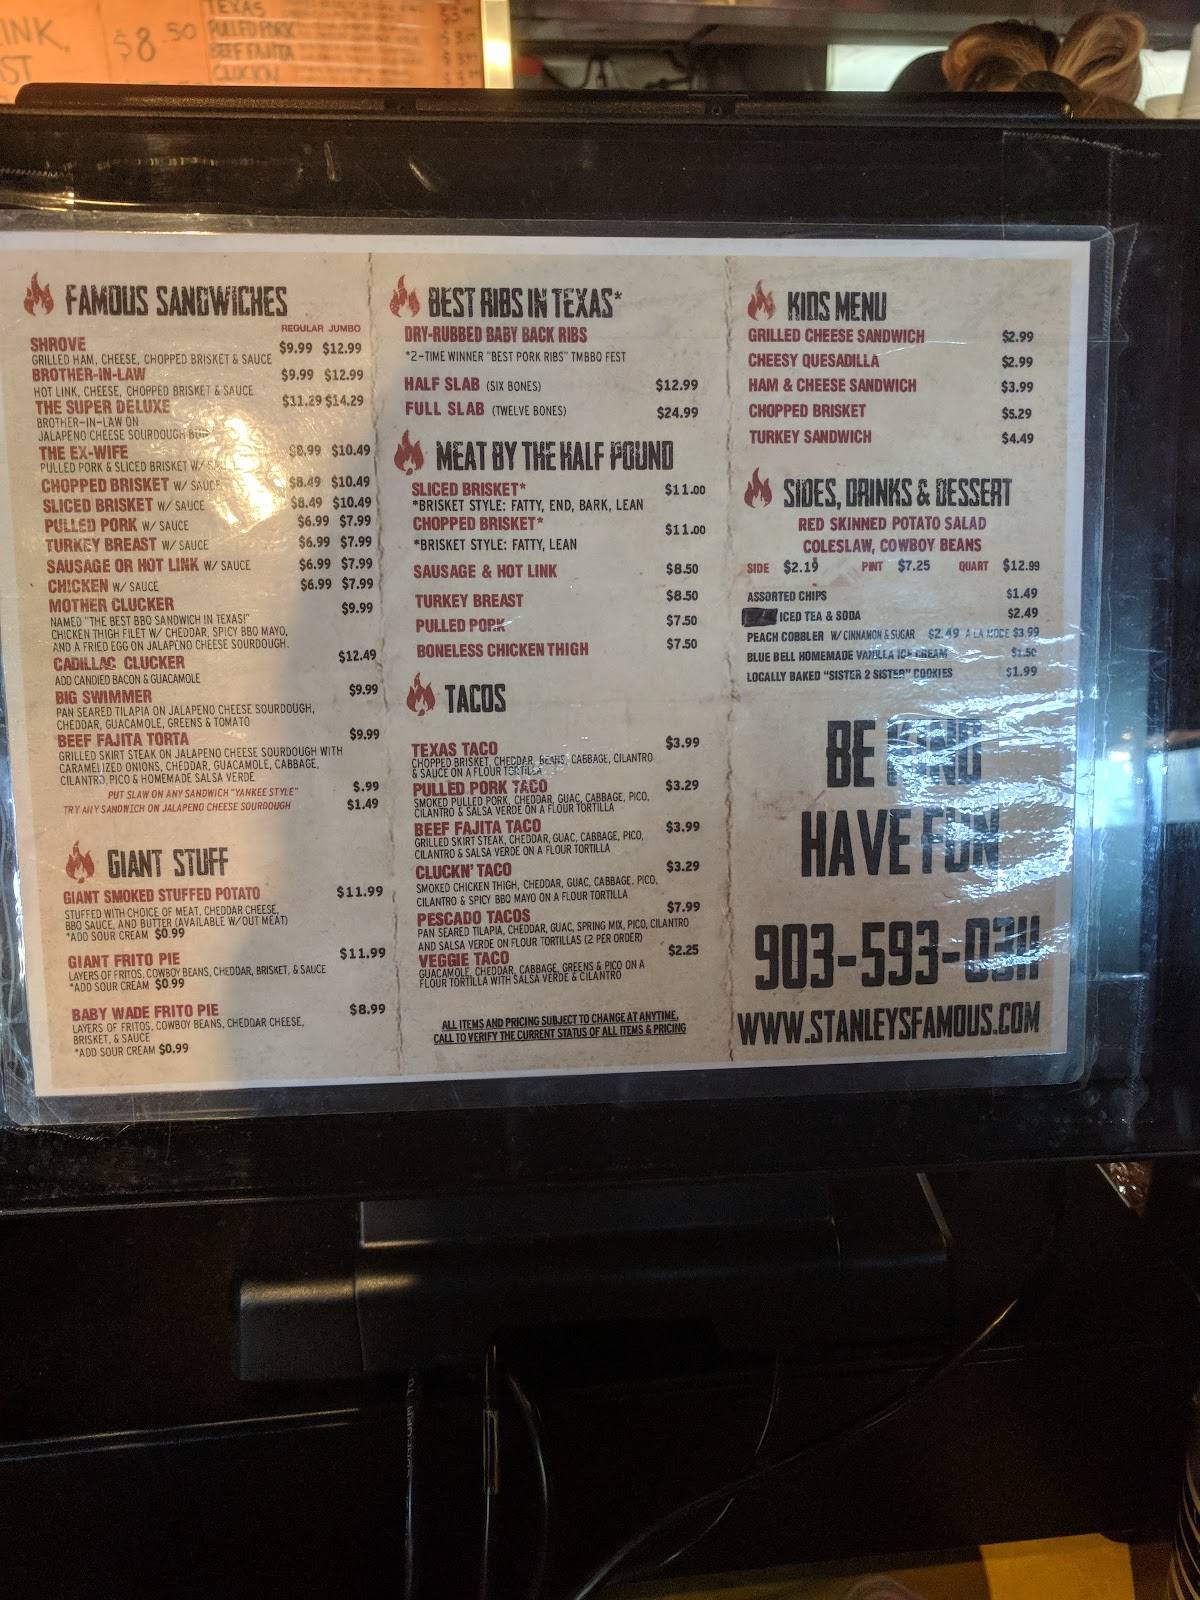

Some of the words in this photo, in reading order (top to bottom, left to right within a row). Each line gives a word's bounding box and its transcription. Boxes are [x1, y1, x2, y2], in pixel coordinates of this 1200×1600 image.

[66, 284, 148, 316] FAMOUS
[156, 285, 287, 316] SANDWICHES
[429, 287, 475, 317] BEST
[480, 288, 523, 318] RIBS
[528, 288, 547, 318] IN
[788, 292, 830, 321] KIDS
[835, 292, 887, 321] MENU
[405, 326, 482, 343] DRY-RUBBED
[486, 327, 517, 343] BABY
[522, 327, 554, 343] BACK
[558, 327, 587, 343] RIBS
[749, 328, 800, 342] GRILLED
[805, 329, 853, 343] CHEESE
[857, 329, 925, 343] SANDWICH
[1002, 330, 1034, 343] $2.99
[30, 337, 86, 351] SHROVE
[280, 341, 312, 355] $9.99
[322, 342, 362, 355] $12.99
[32, 354, 69, 365] GRILLED
[73, 355, 97, 365] HAM,
[101, 354, 139, 365] CHEESE,
[144, 354, 187, 364] CHOPPED
[191, 354, 229, 365] BRISKET
[232, 353, 238, 364] &
[242, 353, 272, 364] SAUCE
[748, 353, 798, 367] CHEESY
[802, 353, 879, 368] QUESADILLA
[1002, 355, 1033, 368] $2.99
[32, 368, 145, 382] BROTHER-IN-LAW
[281, 368, 313, 381] $9.99
[324, 369, 363, 382] $12.99
[405, 377, 440, 391] HALF
[444, 377, 480, 391] SLAB
[487, 381, 503, 392] (SIX
[508, 381, 541, 392] BONES)
[656, 379, 698, 392] $12.99
[35, 400, 62, 415] THE
[66, 400, 112, 414] SUPER
[117, 400, 170, 414] DELUXE
[282, 395, 322, 408] $11.29
[325, 395, 363, 407] $14.29
[750, 430, 800, 444] TURKEY
[804, 429, 872, 444] SANDWICH
[1002, 432, 1034, 445] $4.49
[436, 441, 487, 470] MEAT
[492, 441, 517, 471] BY
[522, 441, 556, 471] THE
[560, 441, 604, 470] HALF
[610, 441, 673, 470] POUND
[412, 482, 458, 496] SLICED
[665, 483, 705, 496] $11.00
[784, 478, 841, 510] SIDES,
[846, 478, 912, 508] DRINKS
[917, 479, 930, 507] &
[936, 478, 1012, 507] DESSERT
[470, 500, 506, 511] STYLE:
[512, 500, 544, 512] FATTY,
[550, 500, 574, 512] END,
[579, 499, 611, 512] BARK,
[616, 499, 643, 510] LEAN
[45, 519, 96, 533] PULLED
[101, 518, 137, 532] PORK
[142, 522, 157, 531] W/
[160, 521, 189, 531] SAUCE
[298, 515, 329, 528] $6.99
[340, 515, 371, 528] $7.99
[799, 518, 824, 532] RED
[830, 517, 886, 531] SKINNED
[892, 516, 940, 530] POTATO
[945, 516, 987, 530] SALAD
[47, 559, 110, 574] SAUSAGE
[115, 559, 133, 572] OR
[138, 559, 163, 572] HOT
[169, 558, 199, 572] LINK
[204, 560, 217, 571] W/
[221, 560, 251, 570] SAUCE
[300, 558, 330, 571] $6.99
[341, 558, 372, 571] $7.99
[414, 564, 476, 578] SAUSAGE
[482, 564, 492, 578] &
[497, 564, 523, 578] HOT
[528, 564, 557, 578] LINK
[666, 563, 698, 575] $8.50
[747, 563, 769, 574] SIDE
[784, 560, 818, 575] $2.19
[862, 561, 883, 572] PINT
[898, 559, 930, 573] $7.25
[959, 561, 988, 571] QUART
[1003, 558, 1040, 572] $12.99
[49, 598, 107, 612] MOTHER
[112, 597, 174, 611] CLUCKER
[342, 602, 373, 615] $9.99
[780, 611, 801, 622] ICED
[805, 611, 822, 621] TEA
[826, 610, 832, 620] &
[836, 610, 861, 620] SODA
[1008, 608, 1038, 620] $2.49
[417, 644, 483, 658] BONELESS
[487, 643, 544, 657] CHICKEN
[548, 642, 588, 656] THIGH
[667, 638, 697, 650] $7.50
[54, 657, 116, 671] CADILLAC
[124, 656, 185, 670] CLUCKER
[339, 649, 376, 663] $12.49
[55, 675, 72, 685] ADD
[74, 675, 110, 685] CANDIED
[113, 675, 140, 684] BACON
[144, 675, 148, 684] &
[151, 673, 200, 684] GUACAMOLE
[445, 684, 506, 713] TACOS
[411, 744, 456, 757] TEXAS
[462, 742, 498, 756] TACO
[666, 736, 699, 750] $3.99
[826, 720, 876, 788] BE
[801, 809, 911, 877] HAVE
[921, 807, 1000, 874] FUN
[108, 850, 162, 878] GIANT
[173, 847, 228, 876] STUFF
[416, 865, 473, 879] CLUCKN'
[477, 862, 512, 877] TACO
[666, 860, 699, 873] $3.29
[64, 891, 99, 905] GIANT
[104, 889, 154, 904] SMOKED
[159, 888, 211, 902] STUFFED
[216, 887, 260, 901] POTATO
[337, 886, 383, 898] $11.99
[72, 1008, 107, 1021] BABY
[112, 1007, 149, 1020] WADE
[154, 1005, 193, 1018] FRITO
[197, 1004, 219, 1016] PIE
[350, 1003, 386, 1016] $8.99
[738, 1001, 1040, 1045] WWW.STANLEYSFAMOUS.COM
[100, 1047, 123, 1056] SOUR
[127, 1046, 155, 1056] CREAM
[159, 1043, 188, 1055] $0.99
